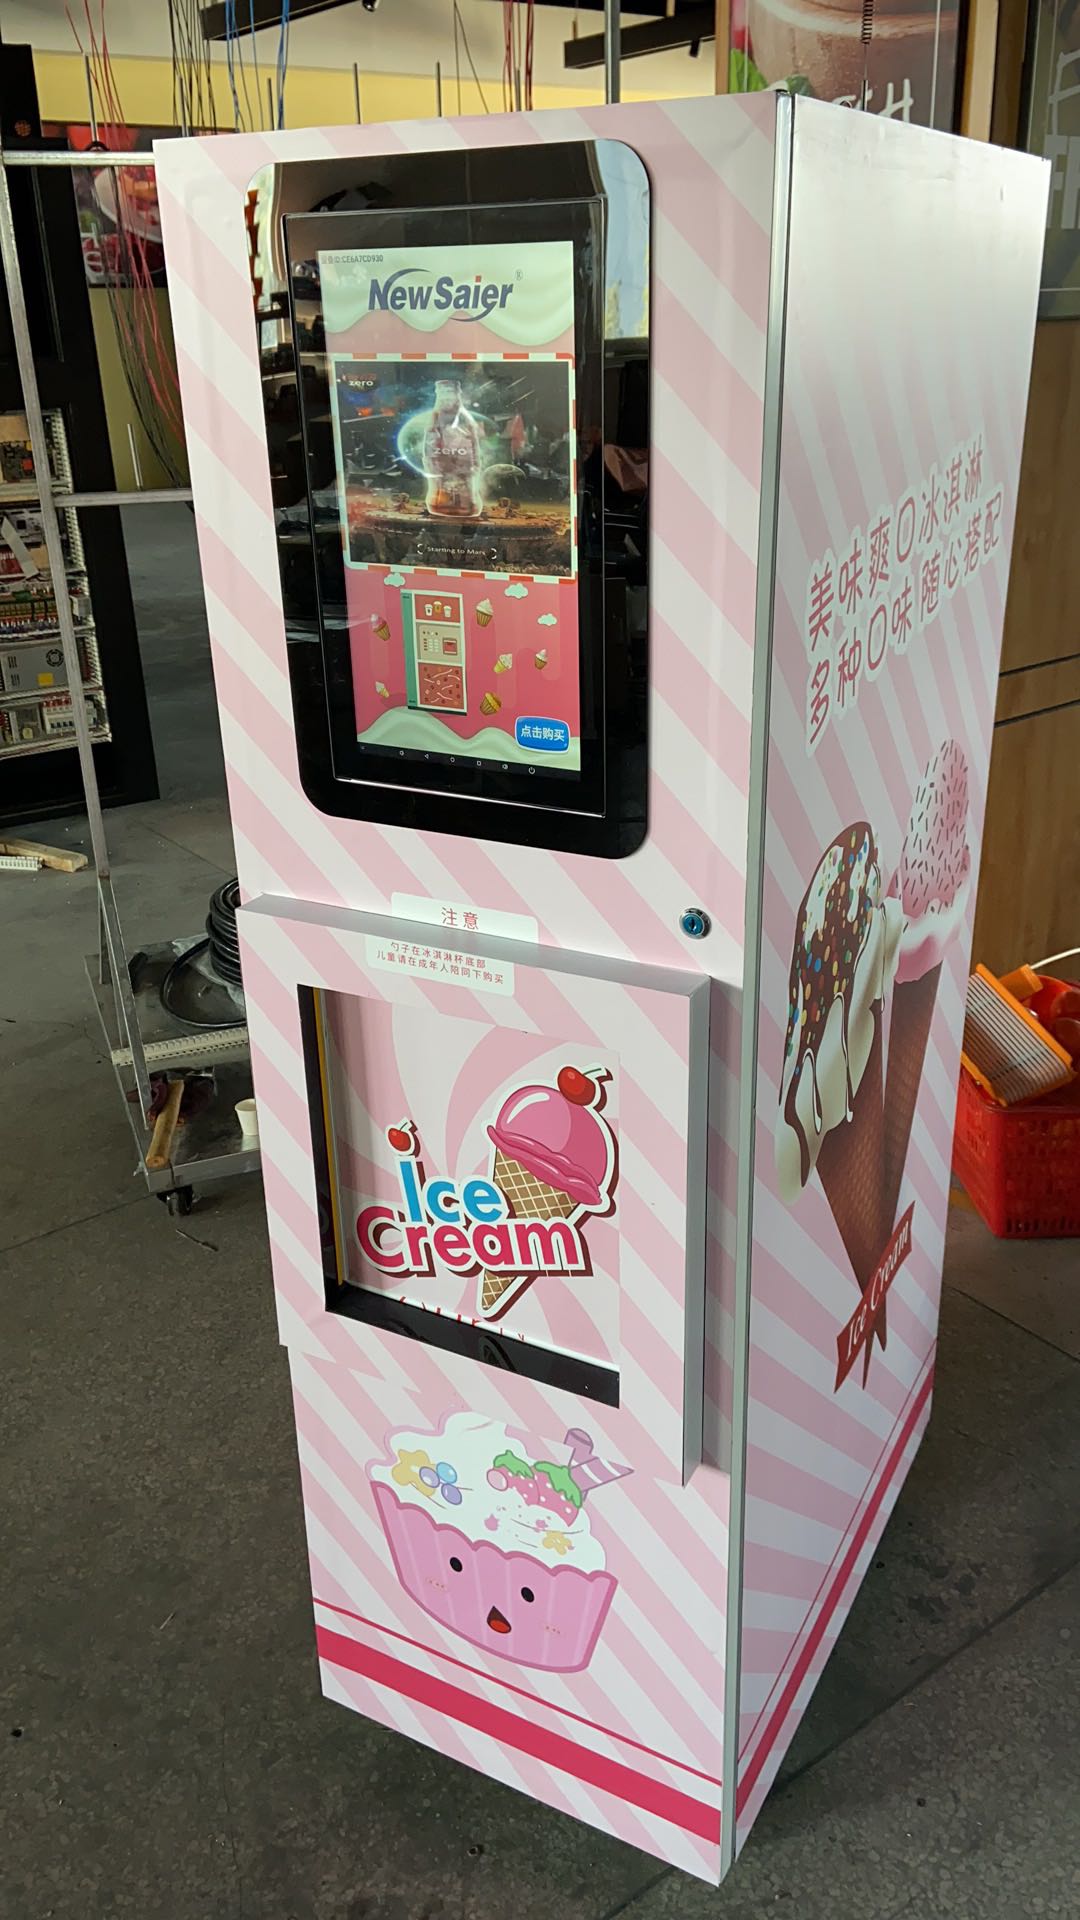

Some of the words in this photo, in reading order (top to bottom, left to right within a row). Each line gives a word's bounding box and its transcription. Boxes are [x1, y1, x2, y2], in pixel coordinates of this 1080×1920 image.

[432, 447, 468, 456] zero
[427, 546, 456, 554] Starting
[808, 432, 983, 651] 美味爽口冰淇淋
[809, 491, 1002, 744] 多种口味随心搭配
[520, 725, 566, 742] 点击购买
[441, 906, 479, 930] 注意
[376, 950, 504, 985] 儿童请在成年人陪同下购买
[390, 941, 486, 968] 勺子在冰淇淋杯底部
[356, 1205, 580, 1269] Cream
[846, 1303, 868, 1362] Ice
[870, 1220, 909, 1312] Cream
